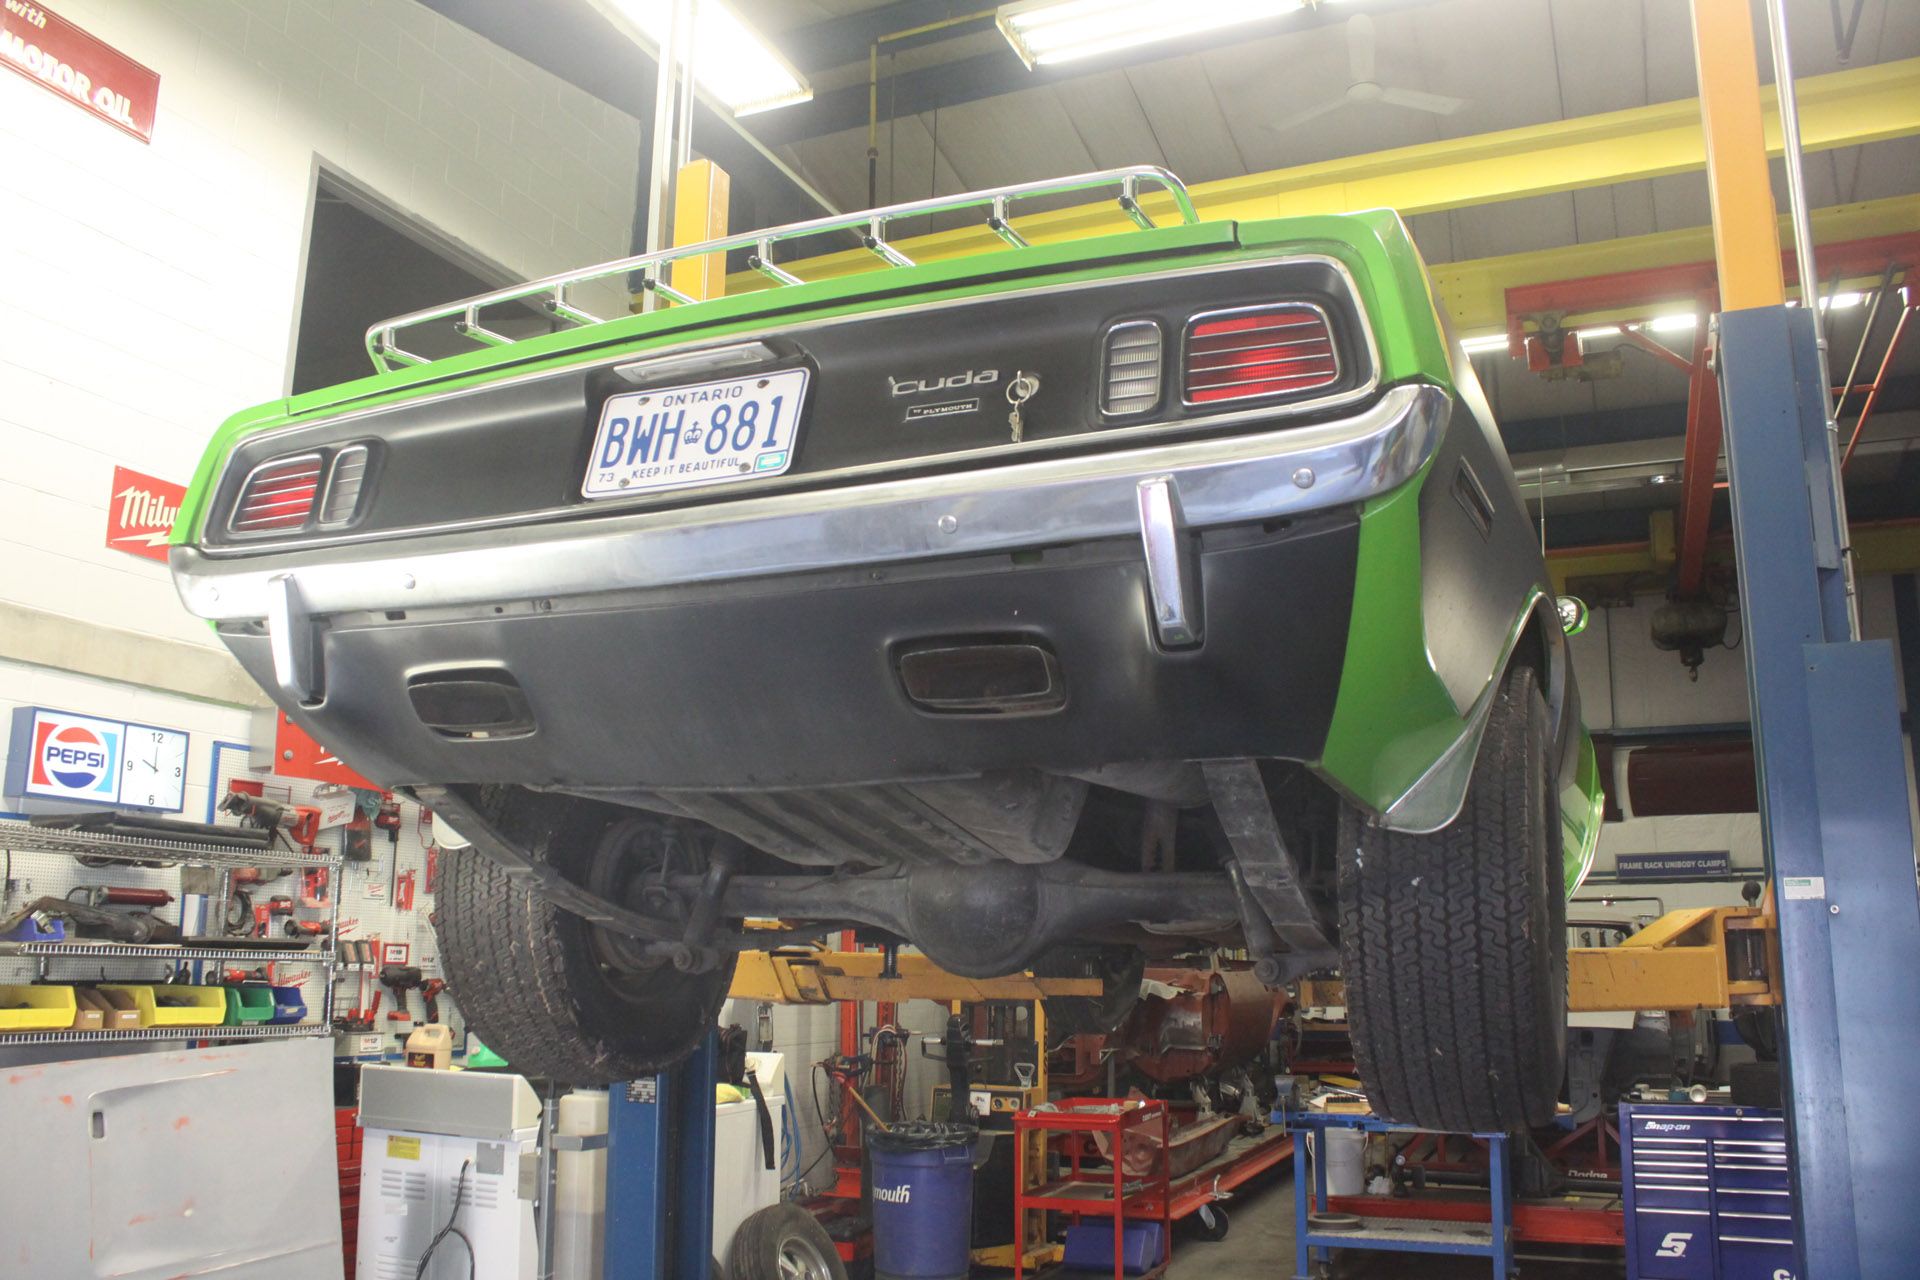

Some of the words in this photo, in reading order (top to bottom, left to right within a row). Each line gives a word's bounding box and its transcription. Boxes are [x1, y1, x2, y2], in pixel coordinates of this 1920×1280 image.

[4, 0, 48, 29] with
[93, 86, 138, 130] OIL
[662, 385, 744, 408] ONTARIO
[923, 403, 973, 415] PLYMOUTH
[599, 409, 686, 469] BWH
[704, 395, 784, 455] 881
[631, 465, 661, 479] KEEP
[664, 464, 674, 475] IT
[678, 457, 740, 474] BEAUTIFUL
[598, 472, 615, 483] 73
[114, 485, 181, 529] Milw
[151, 732, 164, 744] 12
[46, 746, 105, 769] PEPSI
[126, 760, 134, 771] 9
[174, 767, 181, 778] 3
[148, 794, 155, 806] 6
[1619, 861, 1643, 870] FRAME
[1644, 861, 1663, 869] RACK
[1664, 860, 1697, 869] UNIBODY
[1697, 859, 1726, 868] CLAMPS
[1644, 1120, 1692, 1133] Snap-on
